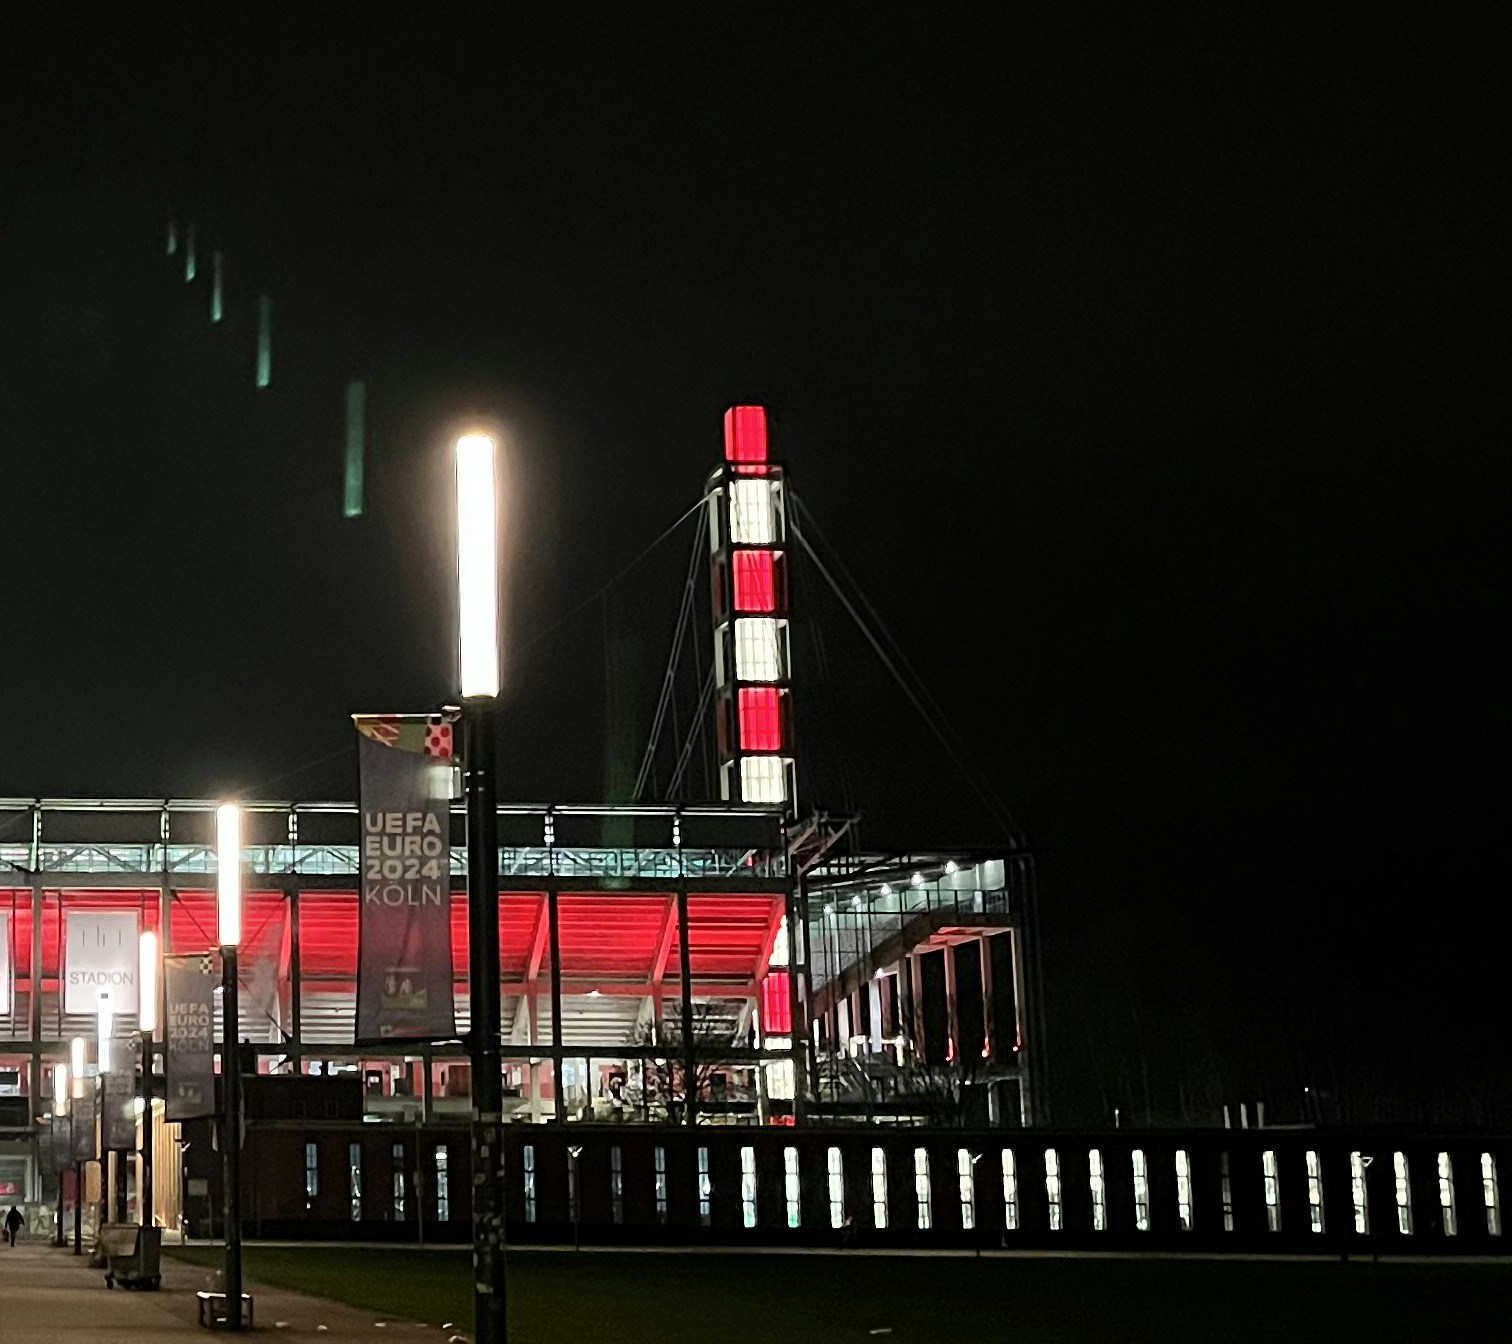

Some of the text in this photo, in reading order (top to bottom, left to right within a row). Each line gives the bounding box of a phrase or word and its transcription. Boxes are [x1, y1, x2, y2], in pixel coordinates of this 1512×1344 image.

[365, 812, 441, 834] UEFA
[365, 836, 442, 857] EURO
[366, 858, 441, 880] 2024
[365, 880, 441, 906] KÖLN
[69, 971, 134, 986] STADION
[169, 1003, 209, 1014] UEFA
[168, 1015, 209, 1026] EURO
[169, 1027, 208, 1038] 2024
